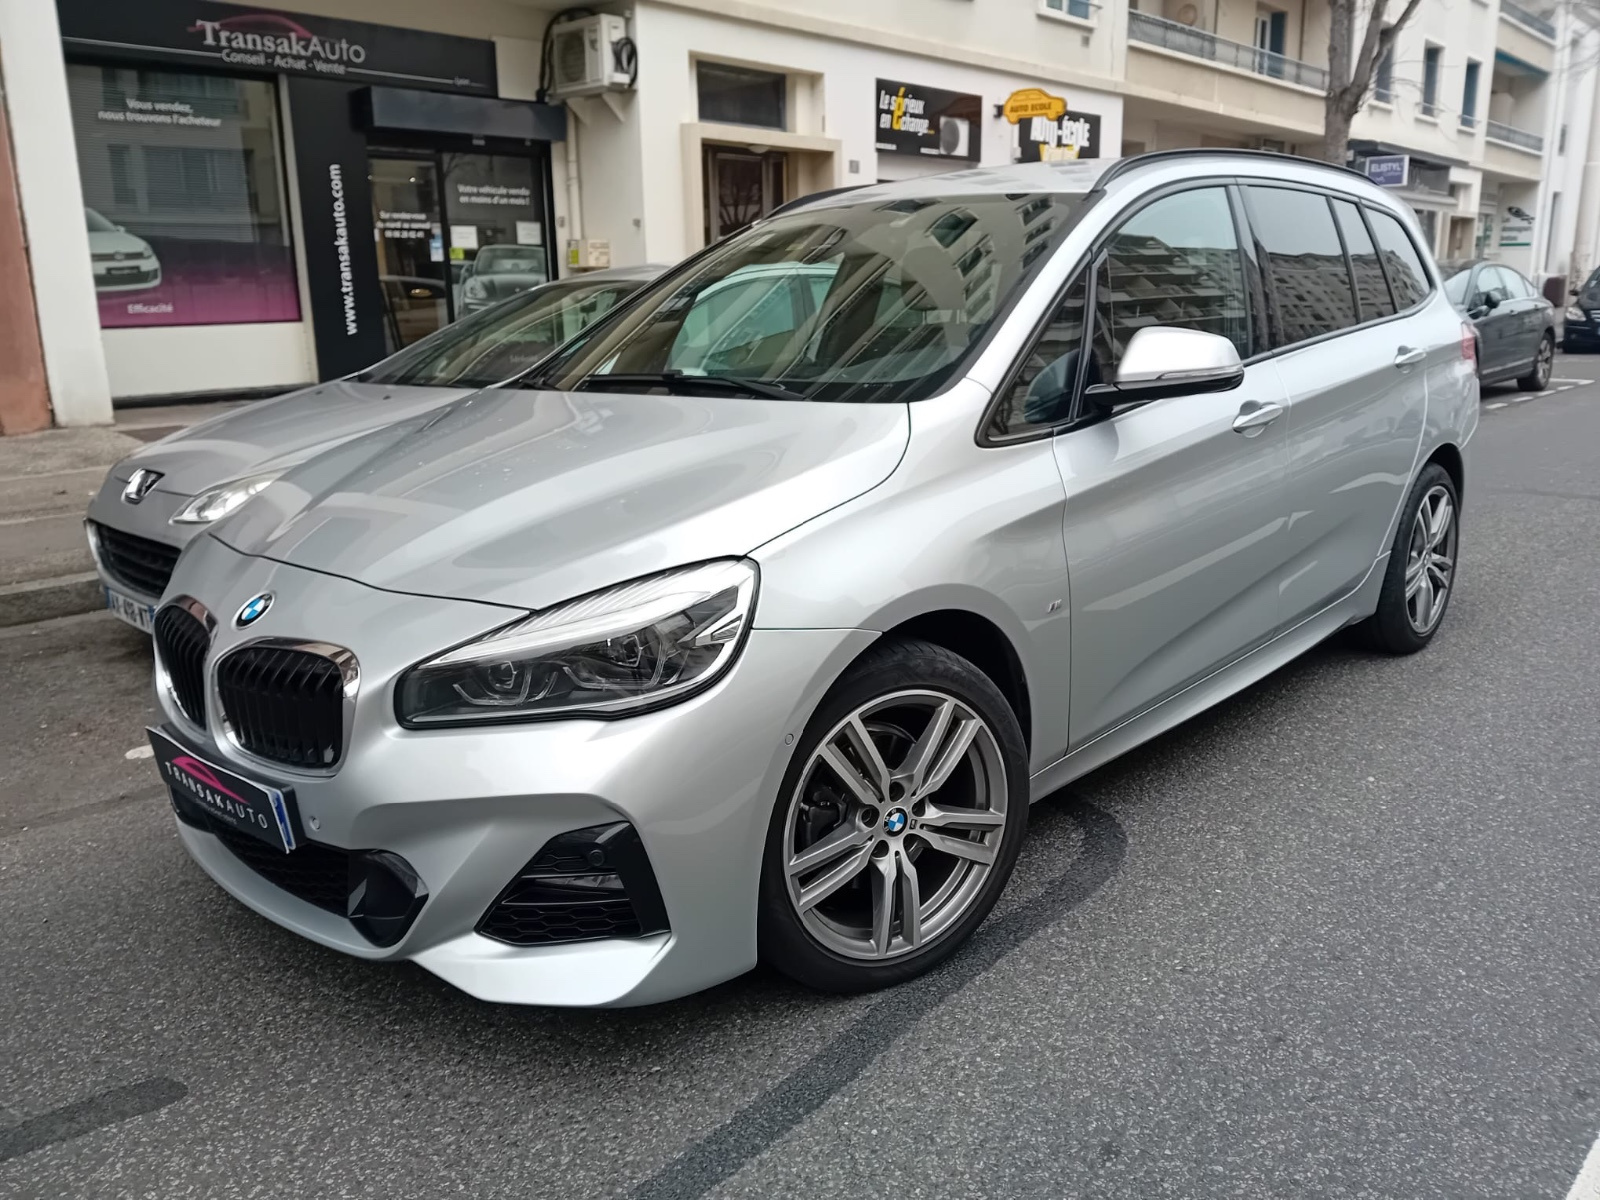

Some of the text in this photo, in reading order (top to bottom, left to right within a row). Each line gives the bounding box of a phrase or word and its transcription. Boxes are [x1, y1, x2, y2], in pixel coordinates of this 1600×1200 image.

[222, 49, 266, 66] Conseil
[273, 55, 307, 70] Achat
[313, 59, 346, 75] Vente
[126, 98, 153, 110] Vous
[879, 87, 926, 116] Le sérieux
[1009, 102, 1052, 113] AUTO ECOLE
[98, 111, 125, 121] nous
[125, 112, 172, 124] trouvons
[879, 113, 892, 129] en
[457, 183, 478, 193] Votre
[459, 196, 469, 204] en
[470, 196, 492, 204] moins
[329, 164, 358, 336] www.transakauto.com
[127, 302, 173, 314] Efficacité
[165, 761, 268, 829] TRANSAKAUTO
